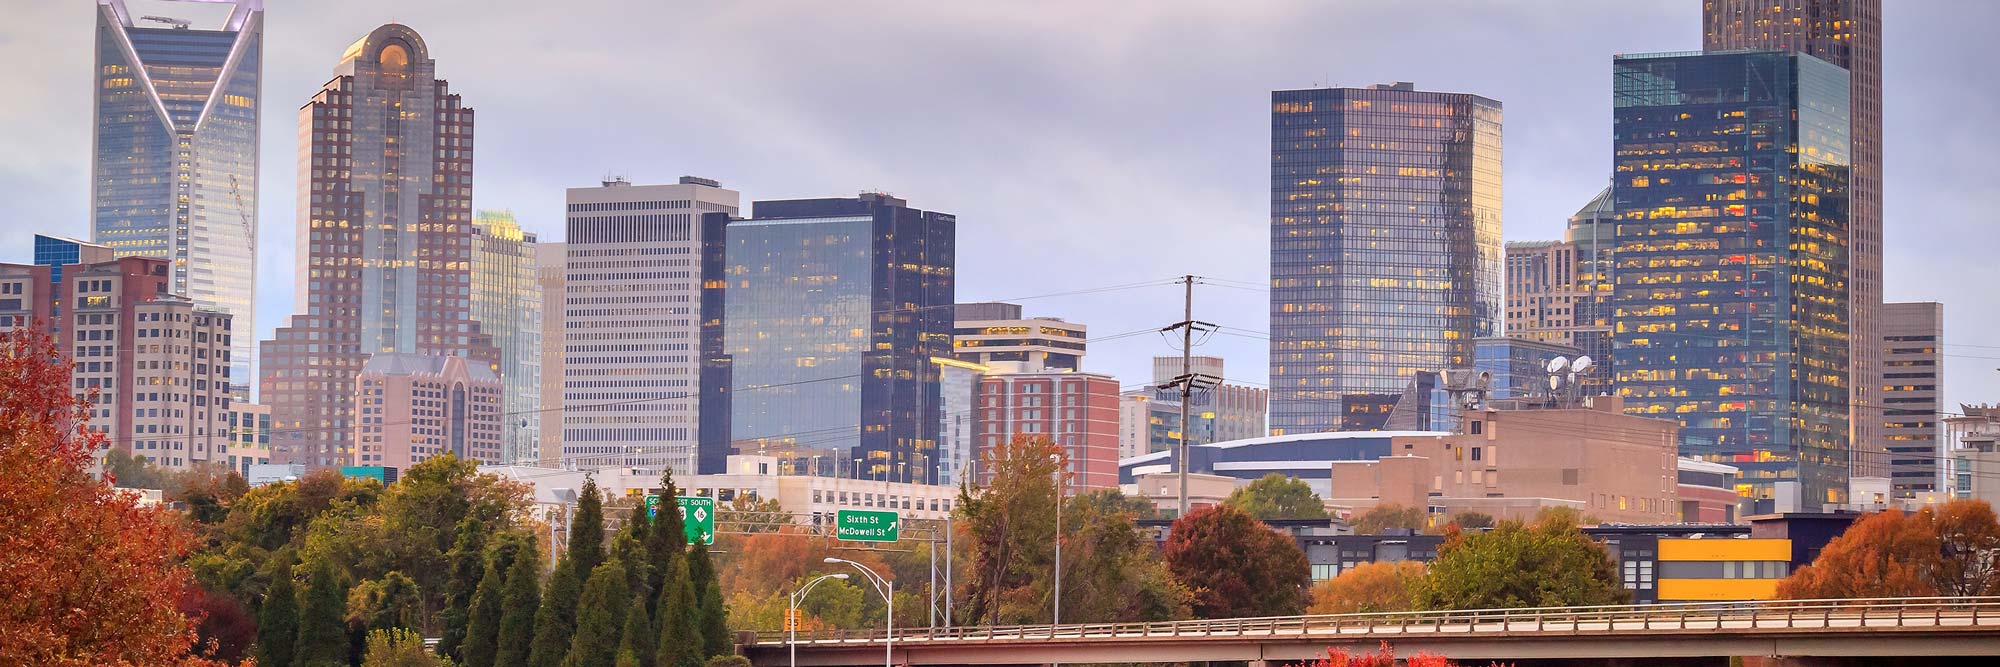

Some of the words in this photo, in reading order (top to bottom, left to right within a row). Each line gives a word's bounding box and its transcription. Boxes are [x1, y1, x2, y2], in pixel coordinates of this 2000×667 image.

[697, 510, 705, 519] 16
[846, 515, 868, 524] Sixth
[869, 516, 879, 524] St
[839, 527, 875, 536] McDowell
[876, 528, 886, 537] St
[787, 618, 799, 627] 35
